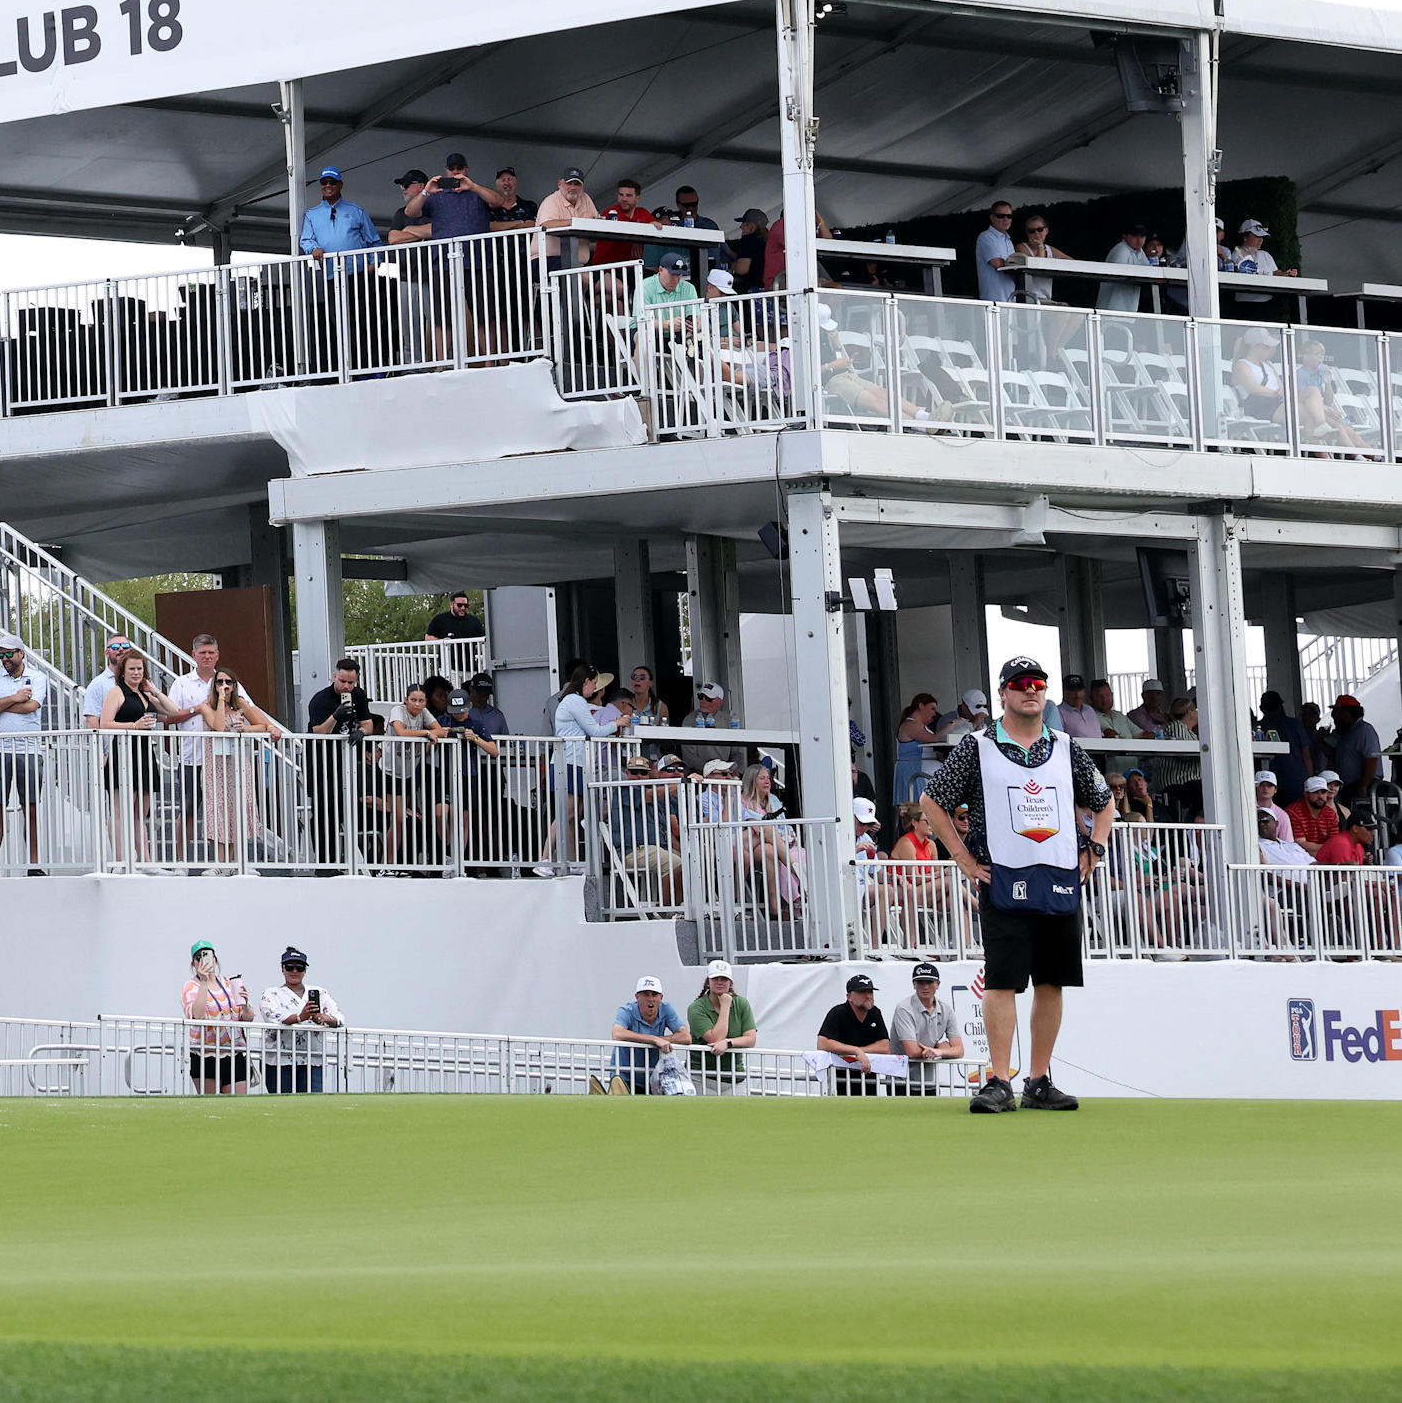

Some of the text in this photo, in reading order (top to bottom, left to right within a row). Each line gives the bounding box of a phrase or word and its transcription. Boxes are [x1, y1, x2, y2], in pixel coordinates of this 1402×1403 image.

[1024, 796, 1045, 804] Texas
[1017, 805, 1053, 813] Children's
[1323, 1009, 1402, 1063] FedE
